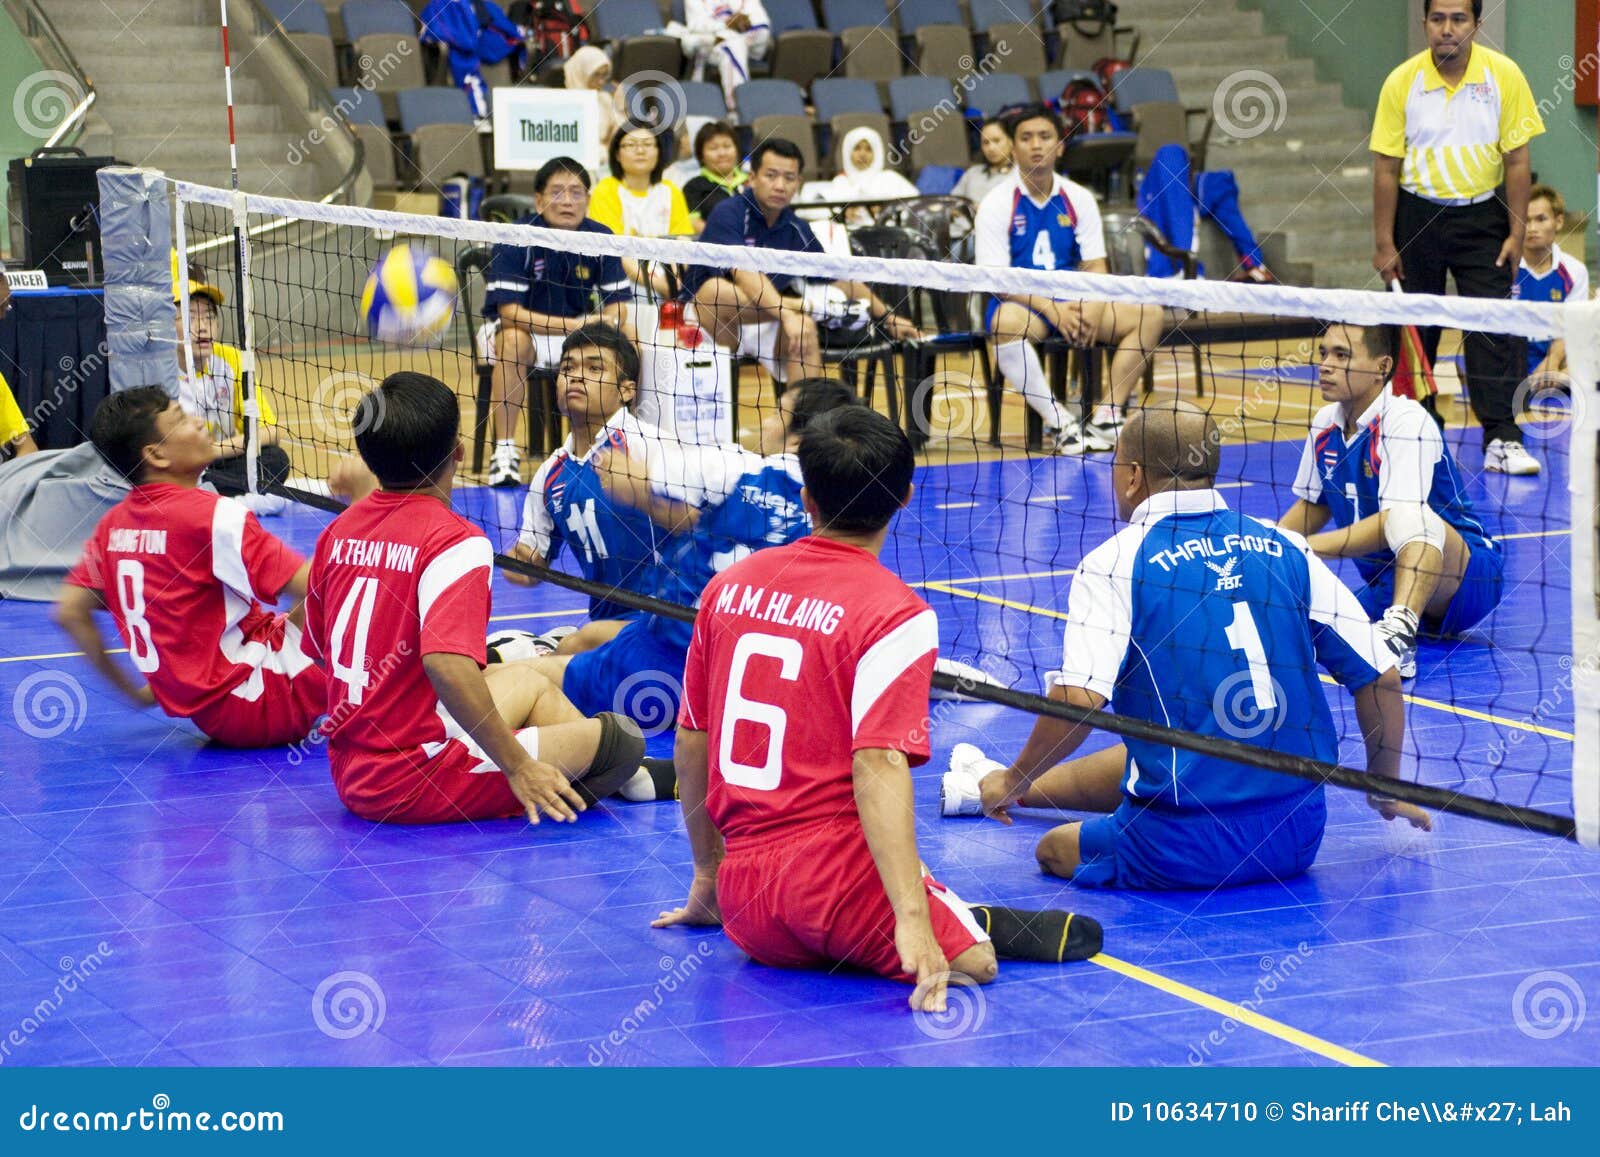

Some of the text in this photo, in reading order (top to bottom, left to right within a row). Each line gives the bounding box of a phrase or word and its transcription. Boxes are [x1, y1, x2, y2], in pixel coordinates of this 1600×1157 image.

[519, 119, 579, 142] Thailand
[1032, 229, 1056, 270] 4
[328, 538, 419, 573] M.THAN WIN
[566, 498, 610, 563] 11
[1149, 534, 1283, 572] THAILAND
[117, 559, 160, 673] 8
[715, 583, 845, 635] M.M.HLAING
[330, 576, 379, 706] 4
[1224, 601, 1277, 710] 1
[719, 632, 803, 791] 6
